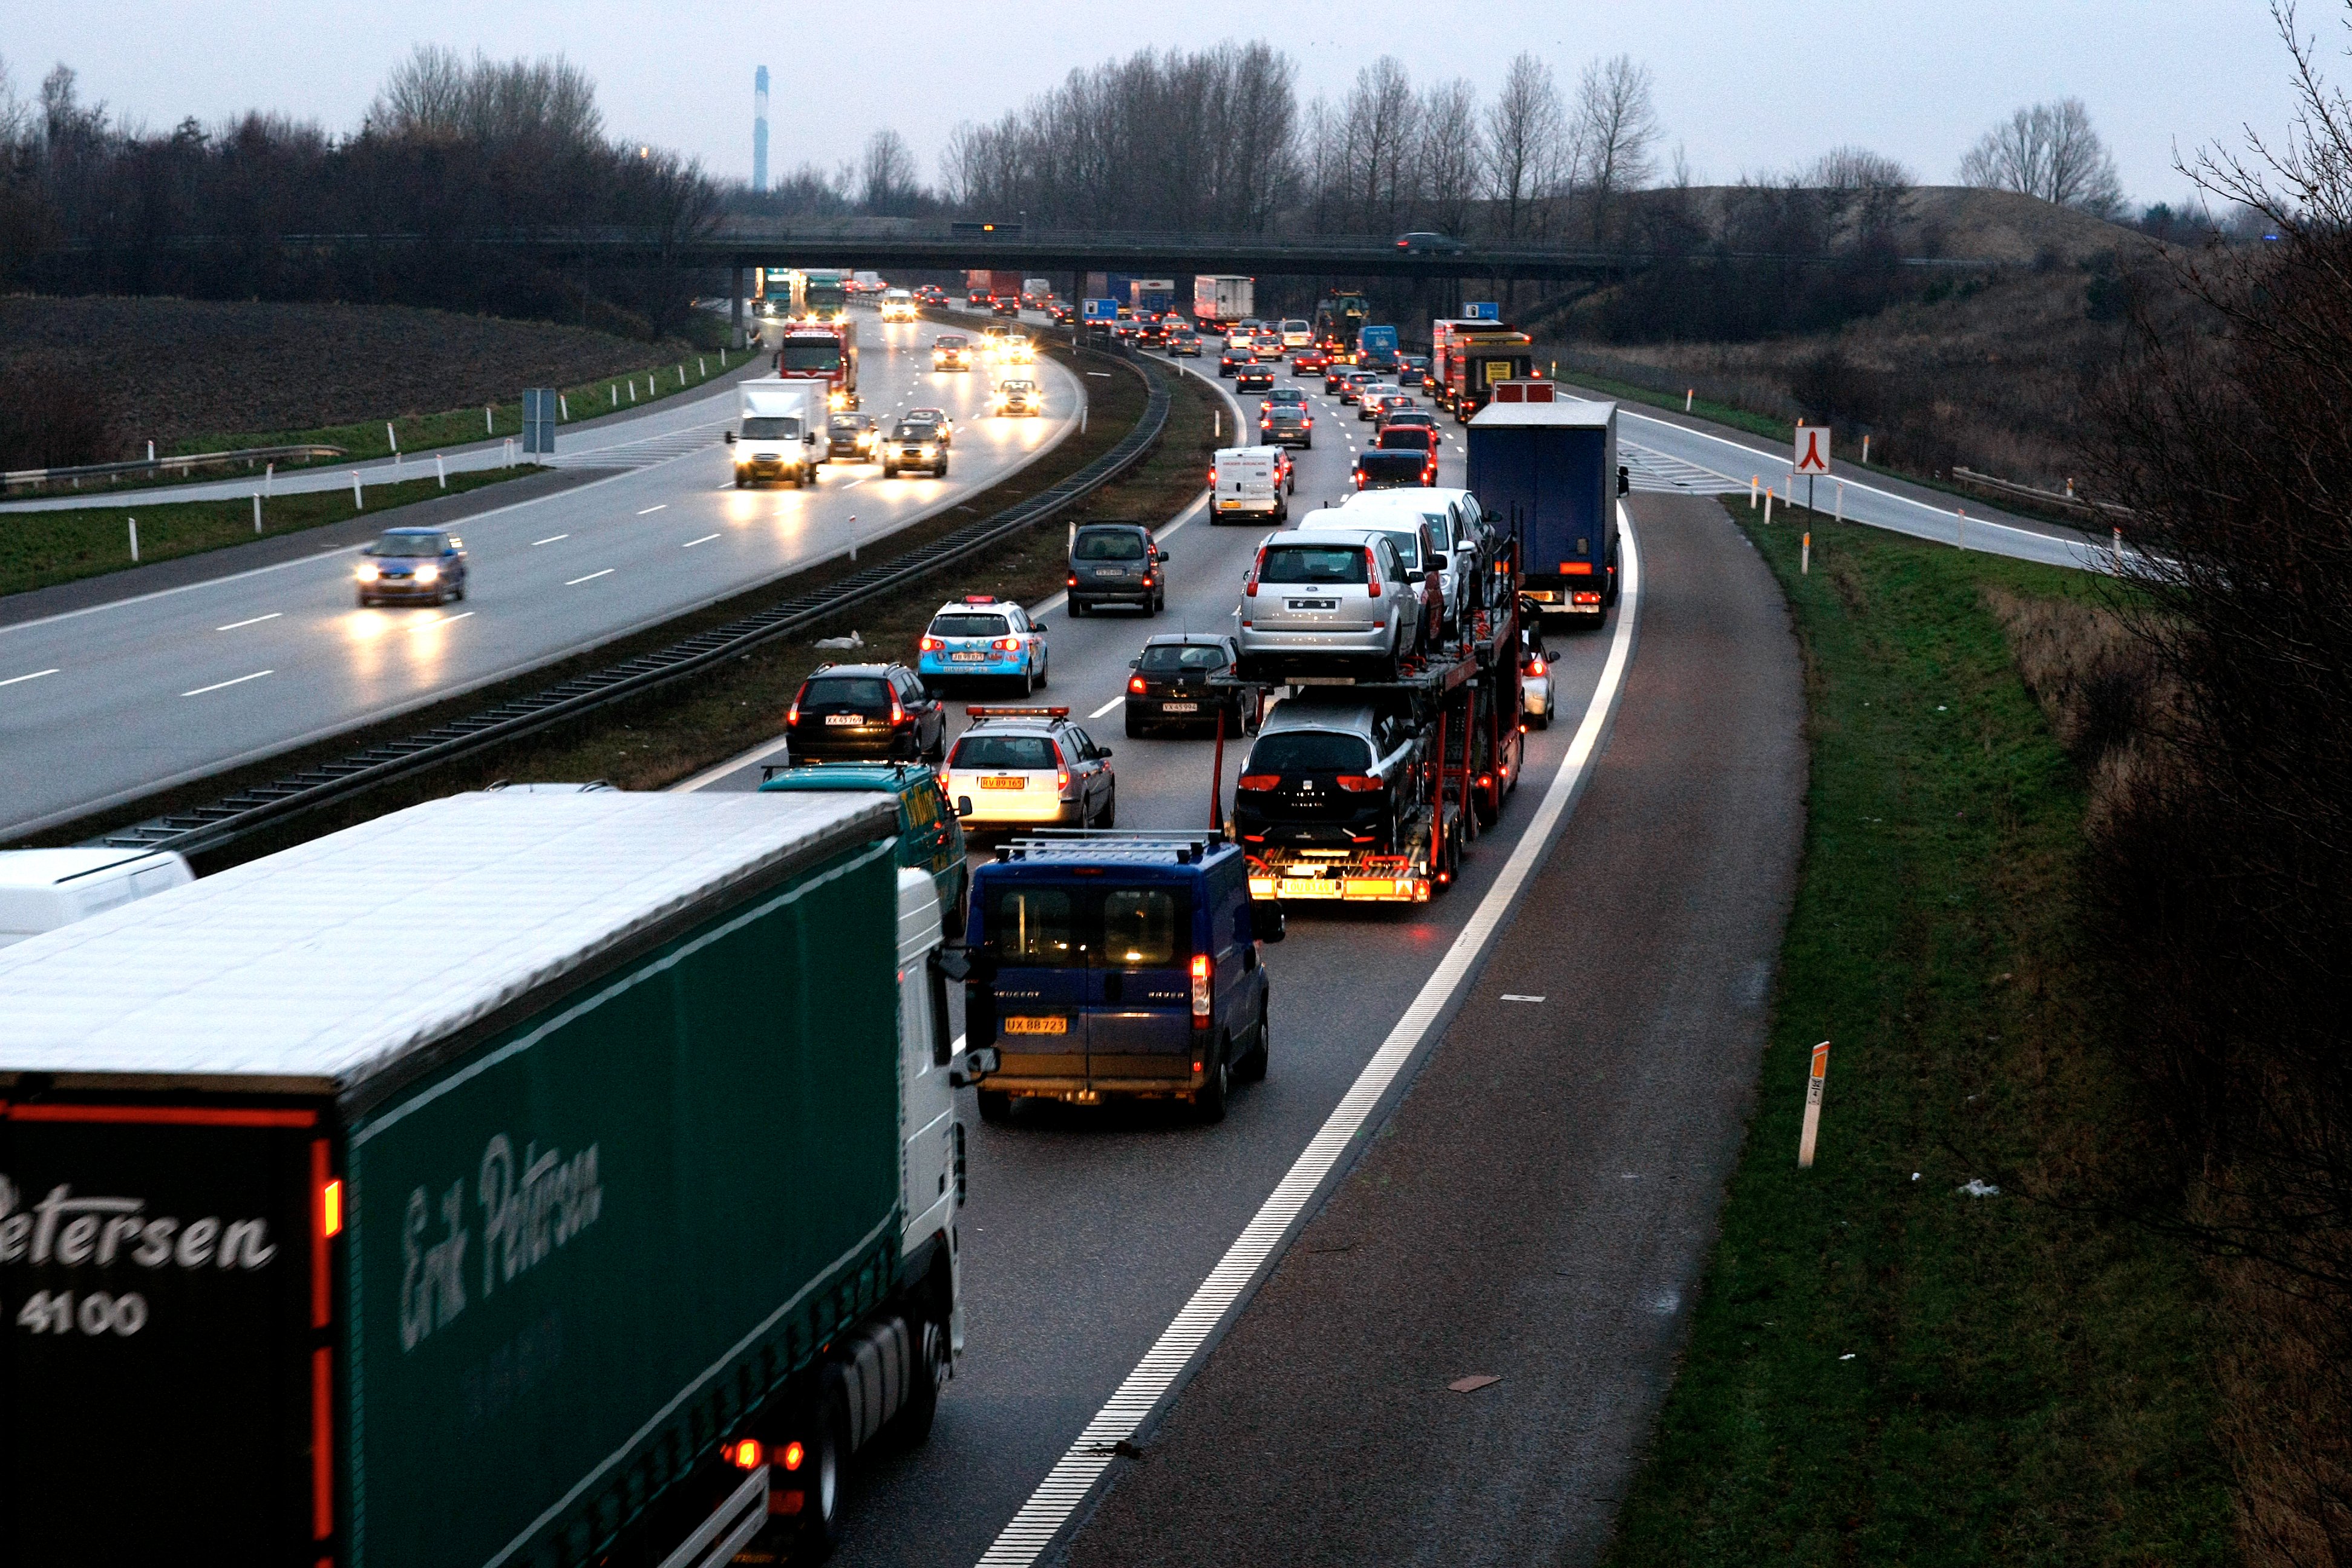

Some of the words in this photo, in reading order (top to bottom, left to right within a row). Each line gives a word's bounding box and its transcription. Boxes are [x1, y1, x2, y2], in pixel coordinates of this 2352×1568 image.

[1007, 1019, 1022, 1030] UX
[1027, 1019, 1040, 1030] 88
[1043, 1019, 1063, 1031] 723
[478, 1132, 603, 1298] Petersen
[16, 1290, 149, 1338] 4100
